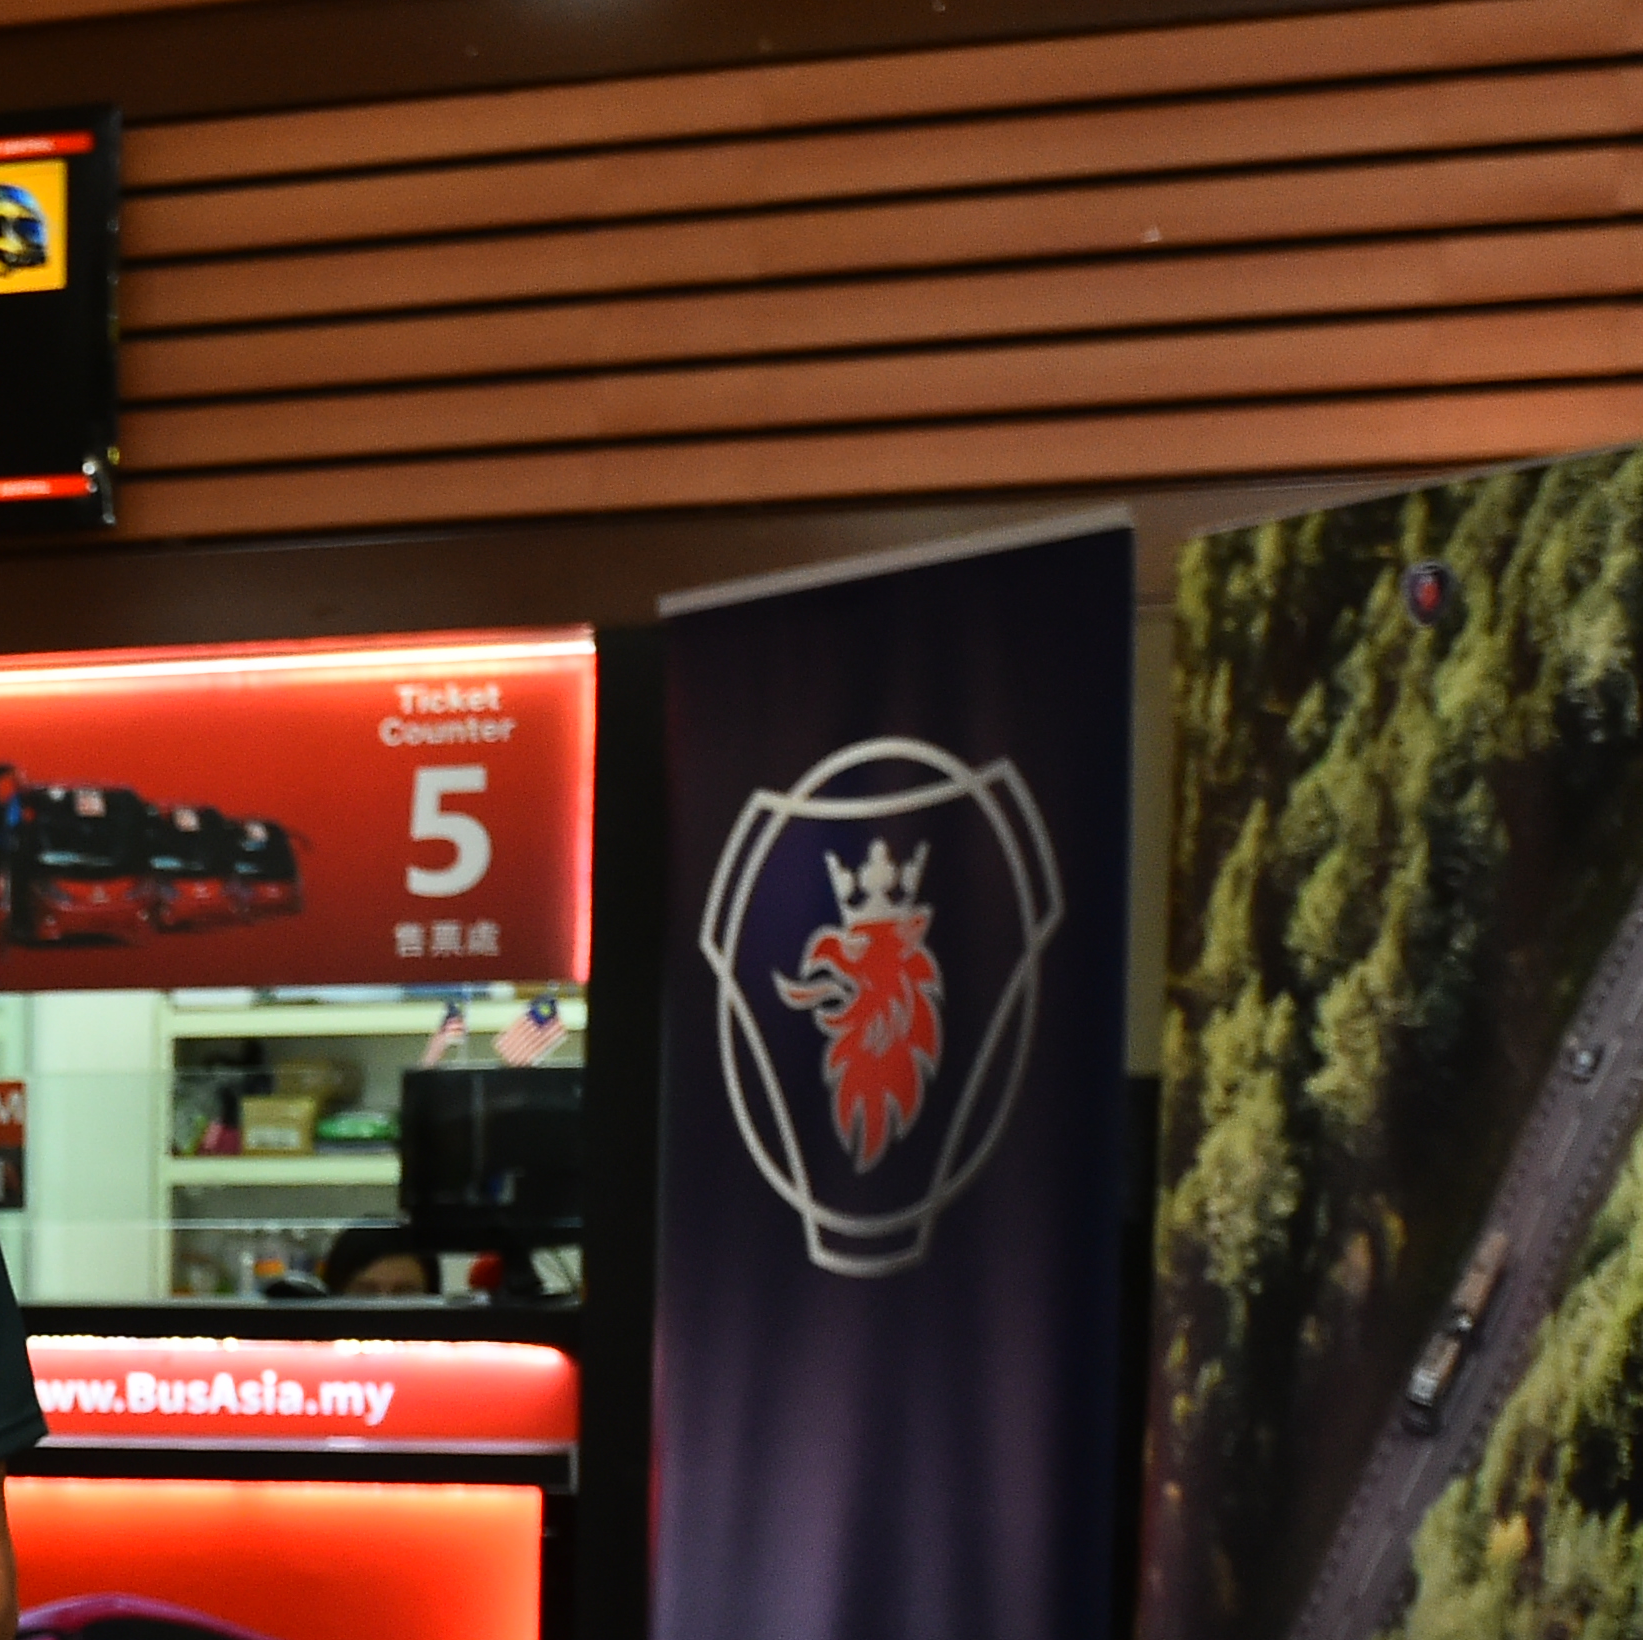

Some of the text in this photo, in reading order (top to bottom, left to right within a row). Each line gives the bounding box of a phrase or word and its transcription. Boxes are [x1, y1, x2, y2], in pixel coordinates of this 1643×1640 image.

[397, 683, 500, 713] Ticket
[378, 716, 517, 746] Counter
[405, 765, 492, 897] 5
[35, 1369, 396, 1426] ww.BusAsia.my
